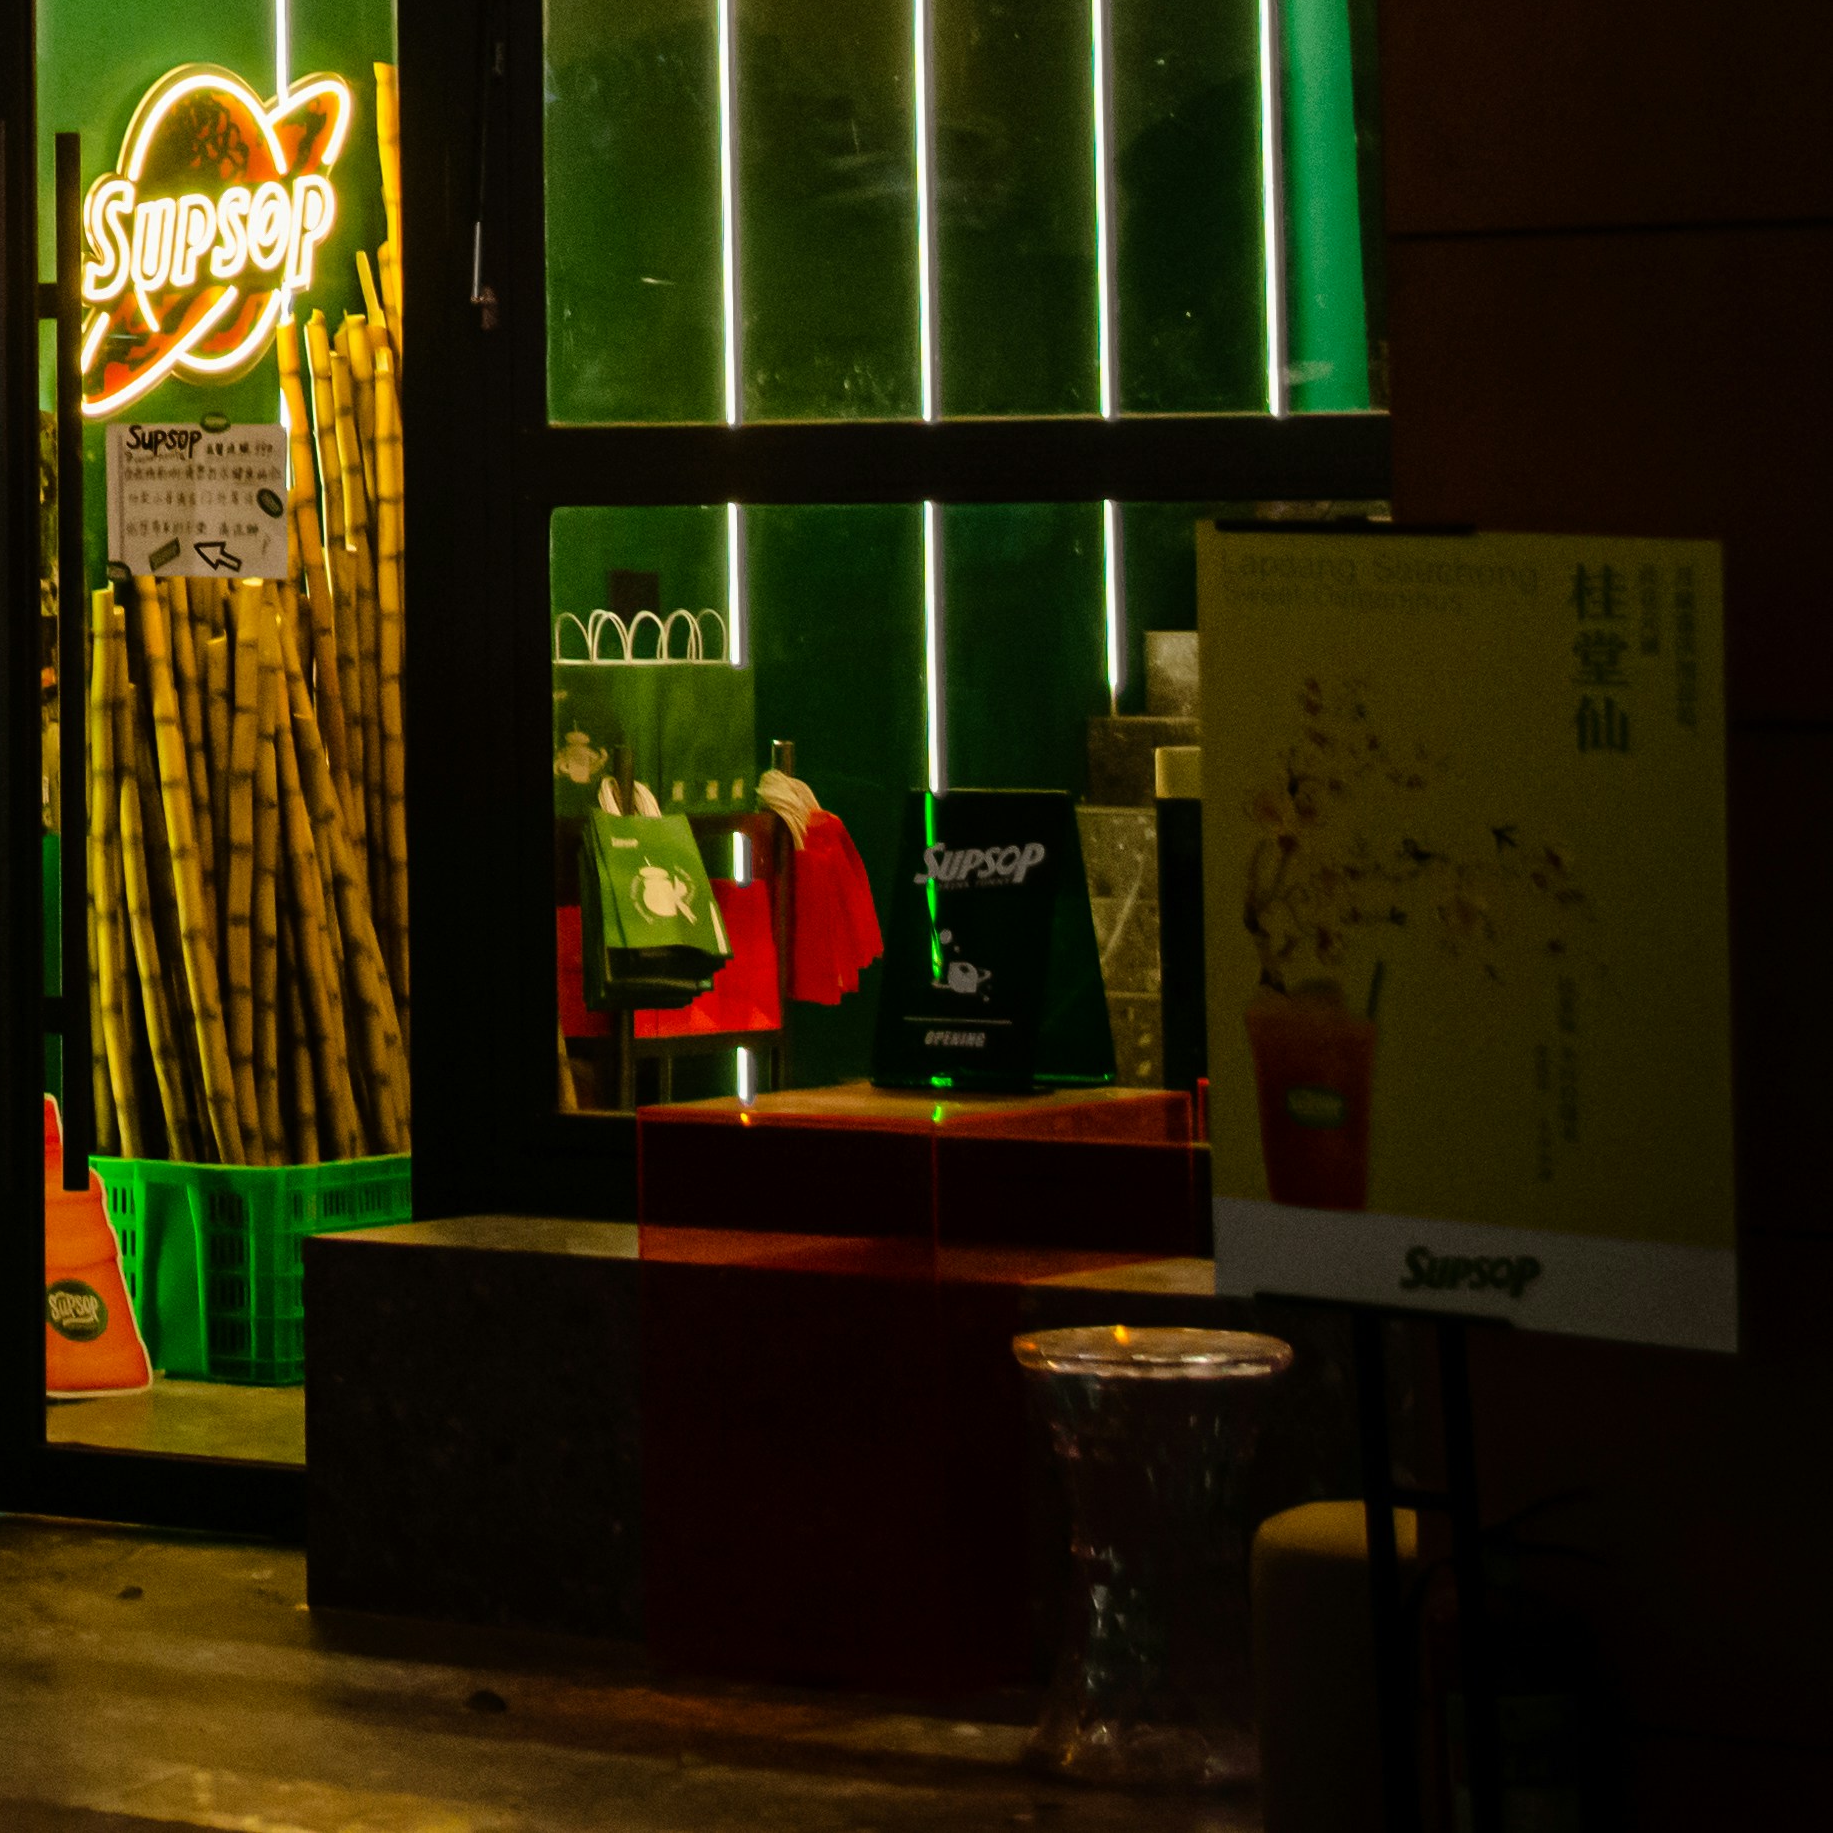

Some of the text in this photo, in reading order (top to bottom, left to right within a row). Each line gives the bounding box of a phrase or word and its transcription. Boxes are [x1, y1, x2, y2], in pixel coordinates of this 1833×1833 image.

[1569, 563, 1630, 754] 桂堂仙
[924, 1030, 986, 1048] OPENING
